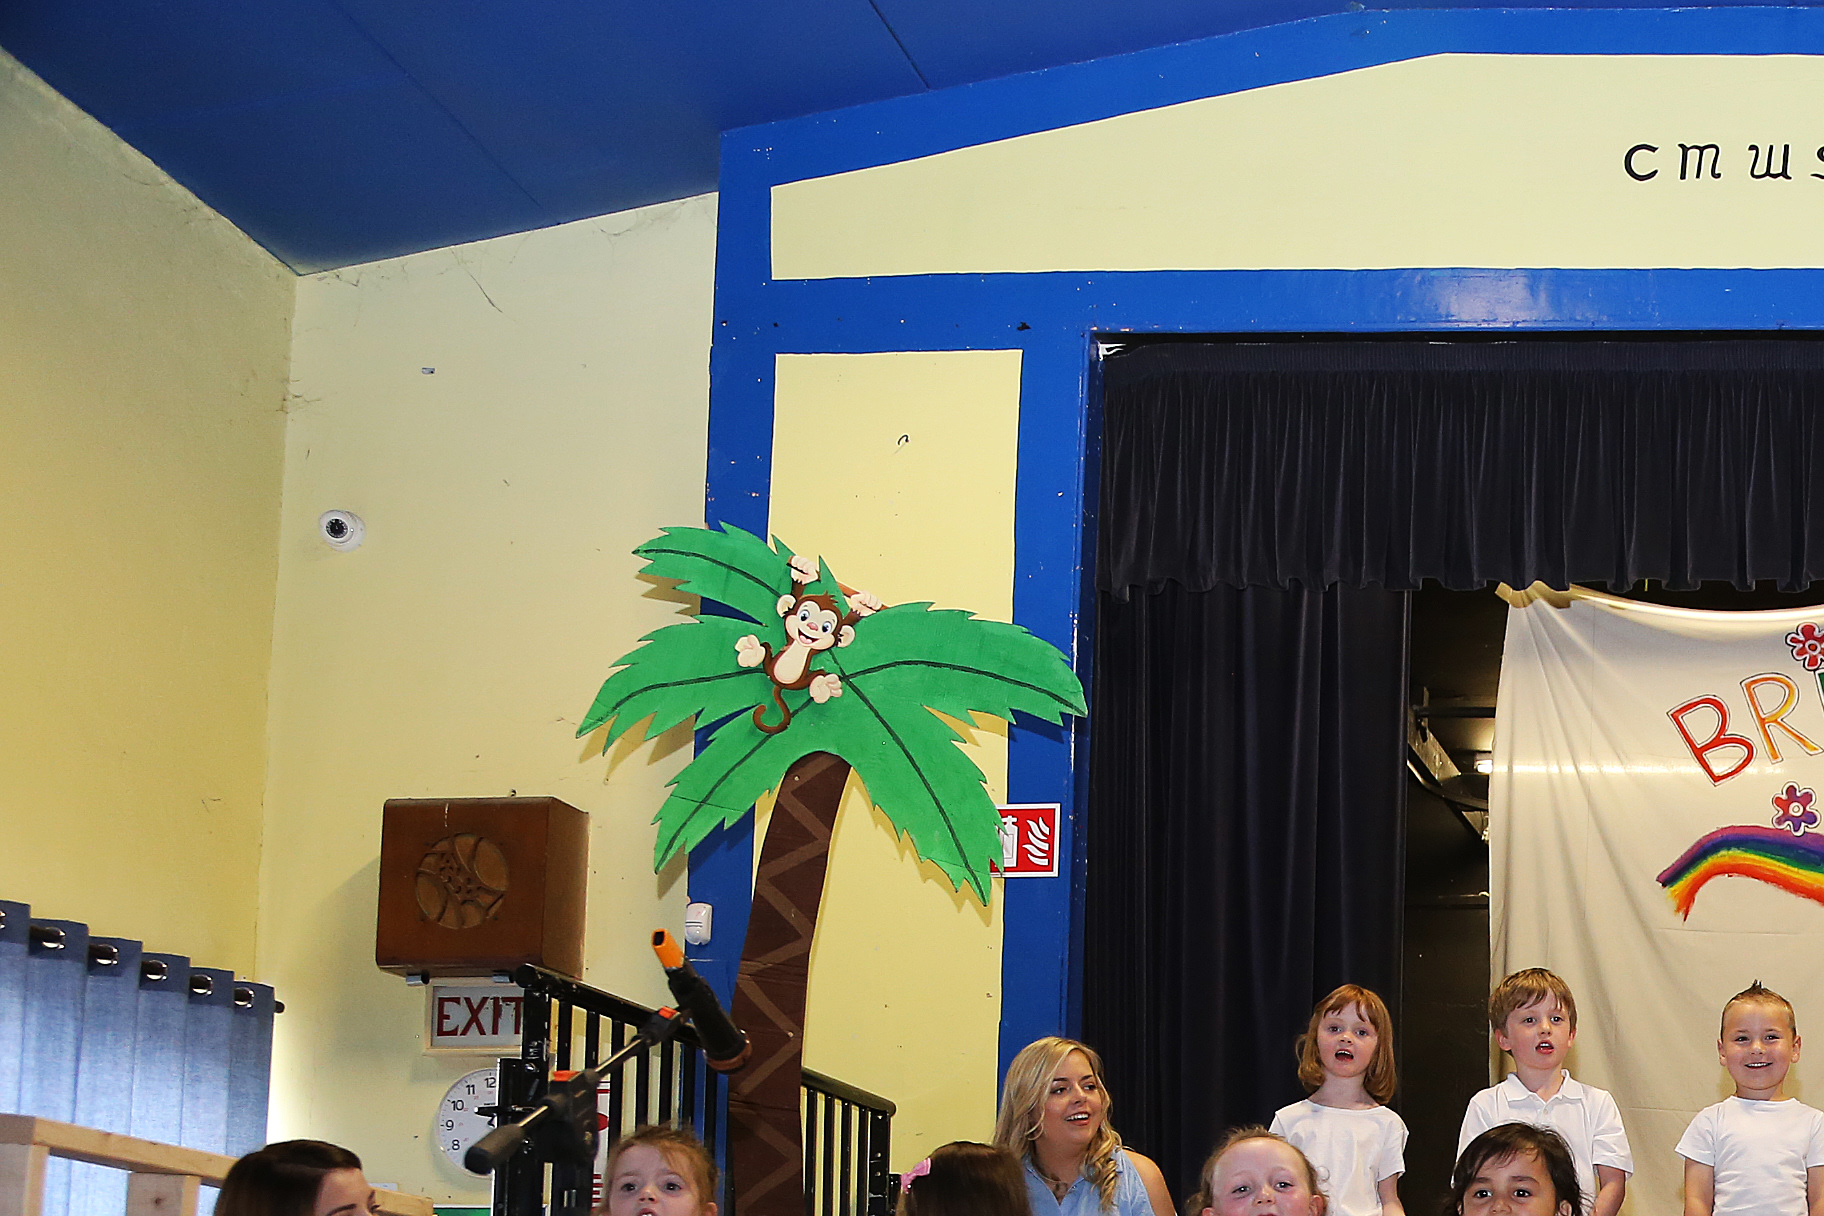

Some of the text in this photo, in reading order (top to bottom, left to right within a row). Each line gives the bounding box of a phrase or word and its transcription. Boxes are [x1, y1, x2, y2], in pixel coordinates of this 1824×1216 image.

[437, 997, 524, 1036] EXIT
[484, 1077, 497, 1089] 12
[466, 1084, 476, 1095] 11
[451, 1099, 464, 1111] 10
[446, 1119, 454, 1131] 9
[452, 1139, 460, 1151] 8
